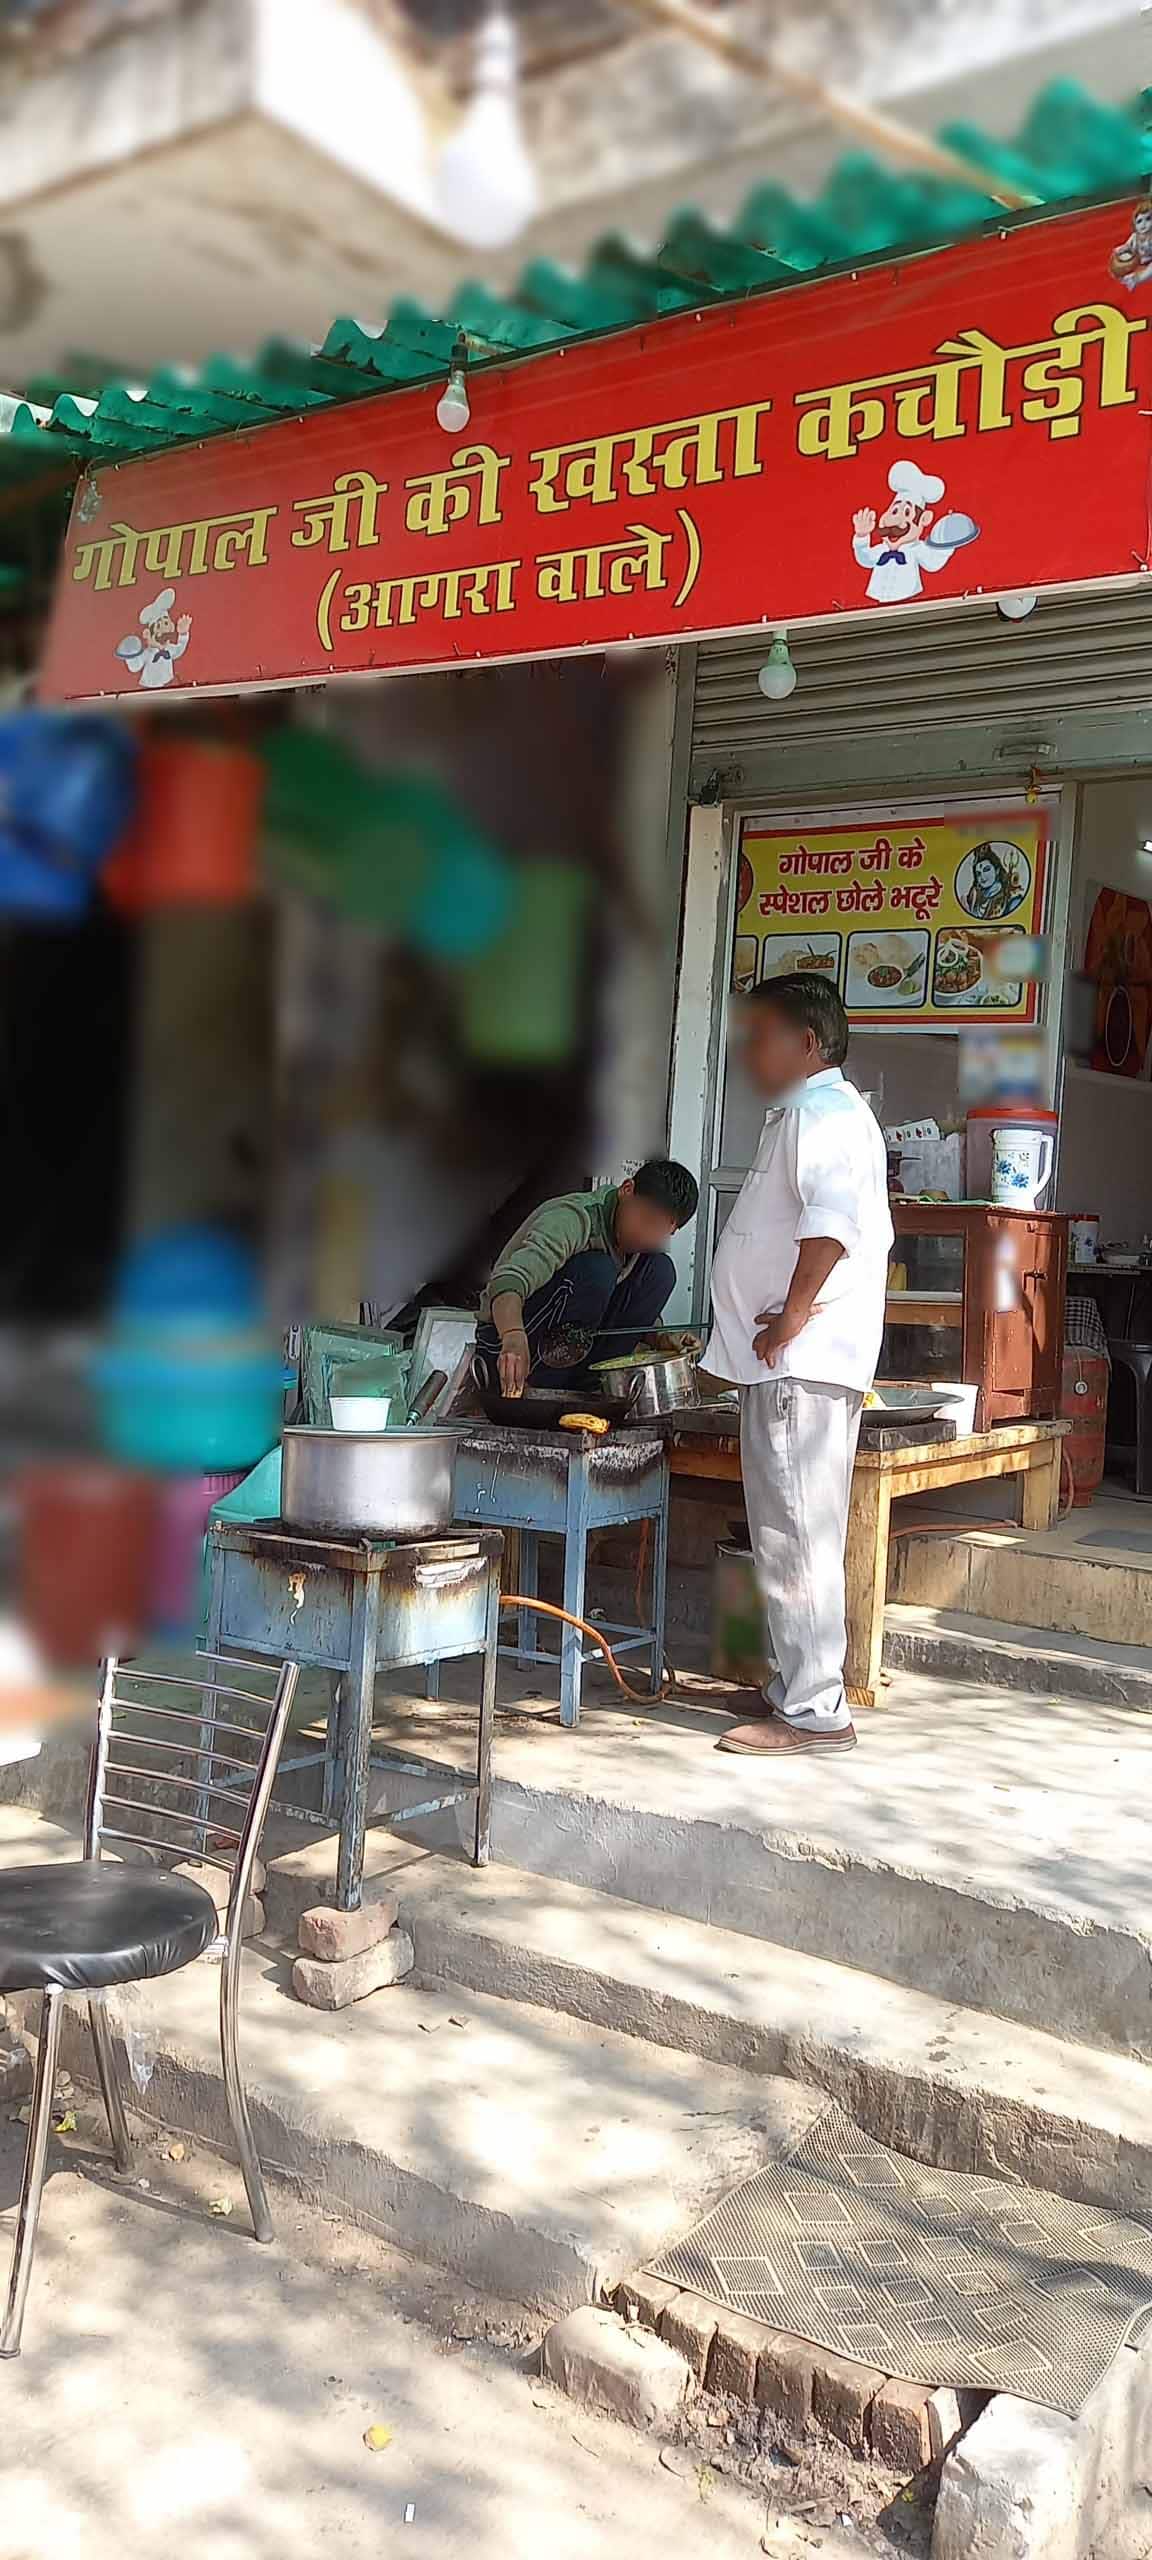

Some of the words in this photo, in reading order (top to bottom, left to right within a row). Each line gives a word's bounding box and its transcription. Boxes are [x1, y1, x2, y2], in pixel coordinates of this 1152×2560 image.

[72, 506, 276, 591] गोपाल
[292, 471, 387, 552] जी
[406, 444, 511, 535] की
[795, 303, 1149, 460] कचौड़ी
[318, 573, 516, 651] (आगरा
[537, 509, 701, 604] वाले)
[759, 884, 830, 916] स्पेशल
[836, 880, 886, 913] छोले
[890, 876, 943, 921] भटूरे
[779, 845, 853, 875] गोपाल
[860, 837, 892, 870] जी
[898, 837, 925, 869] के
